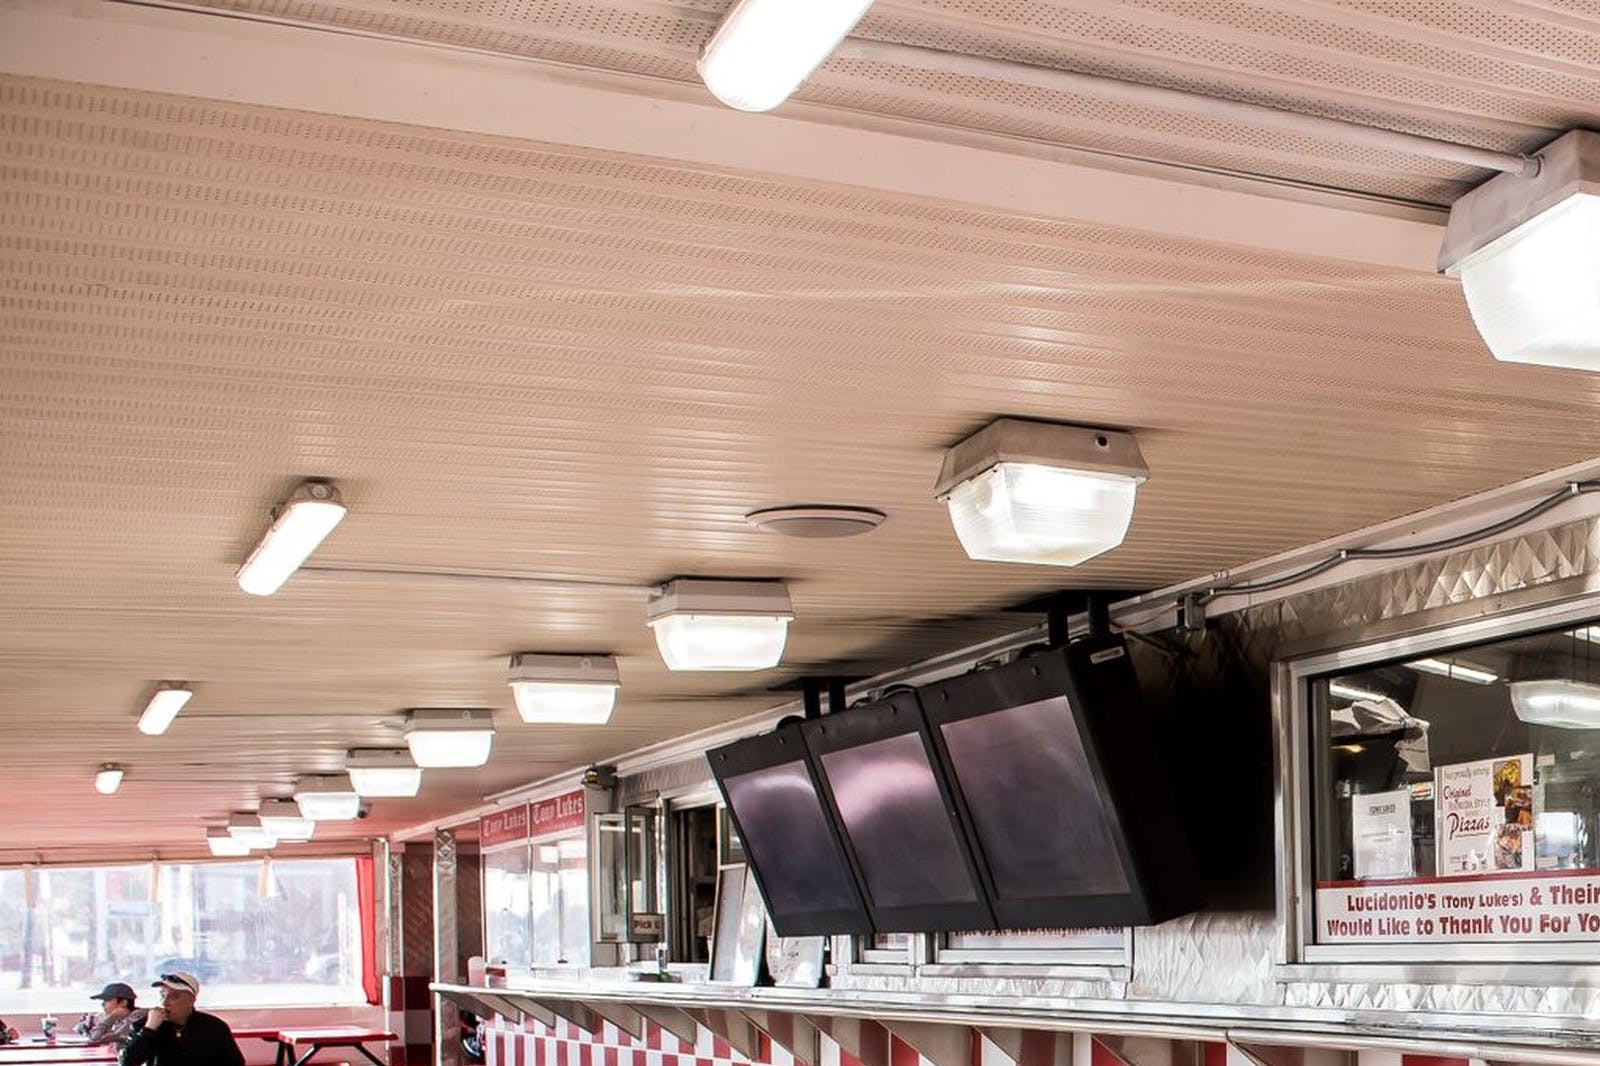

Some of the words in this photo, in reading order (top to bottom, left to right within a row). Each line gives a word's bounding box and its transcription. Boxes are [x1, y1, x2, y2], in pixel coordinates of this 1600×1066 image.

[1446, 812, 1490, 840] Pizzas
[1347, 891, 1437, 912] Lucidonio's
[1441, 895, 1475, 910] (Tony
[1479, 892, 1523, 908] Luke's)
[1529, 886, 1543, 906] &
[1327, 917, 1373, 937] Would
[1378, 916, 1410, 936] Like
[1416, 918, 1434, 935] to
[1439, 914, 1494, 935] Thank
[1499, 914, 1533, 934] You
[1539, 913, 1571, 933] For
